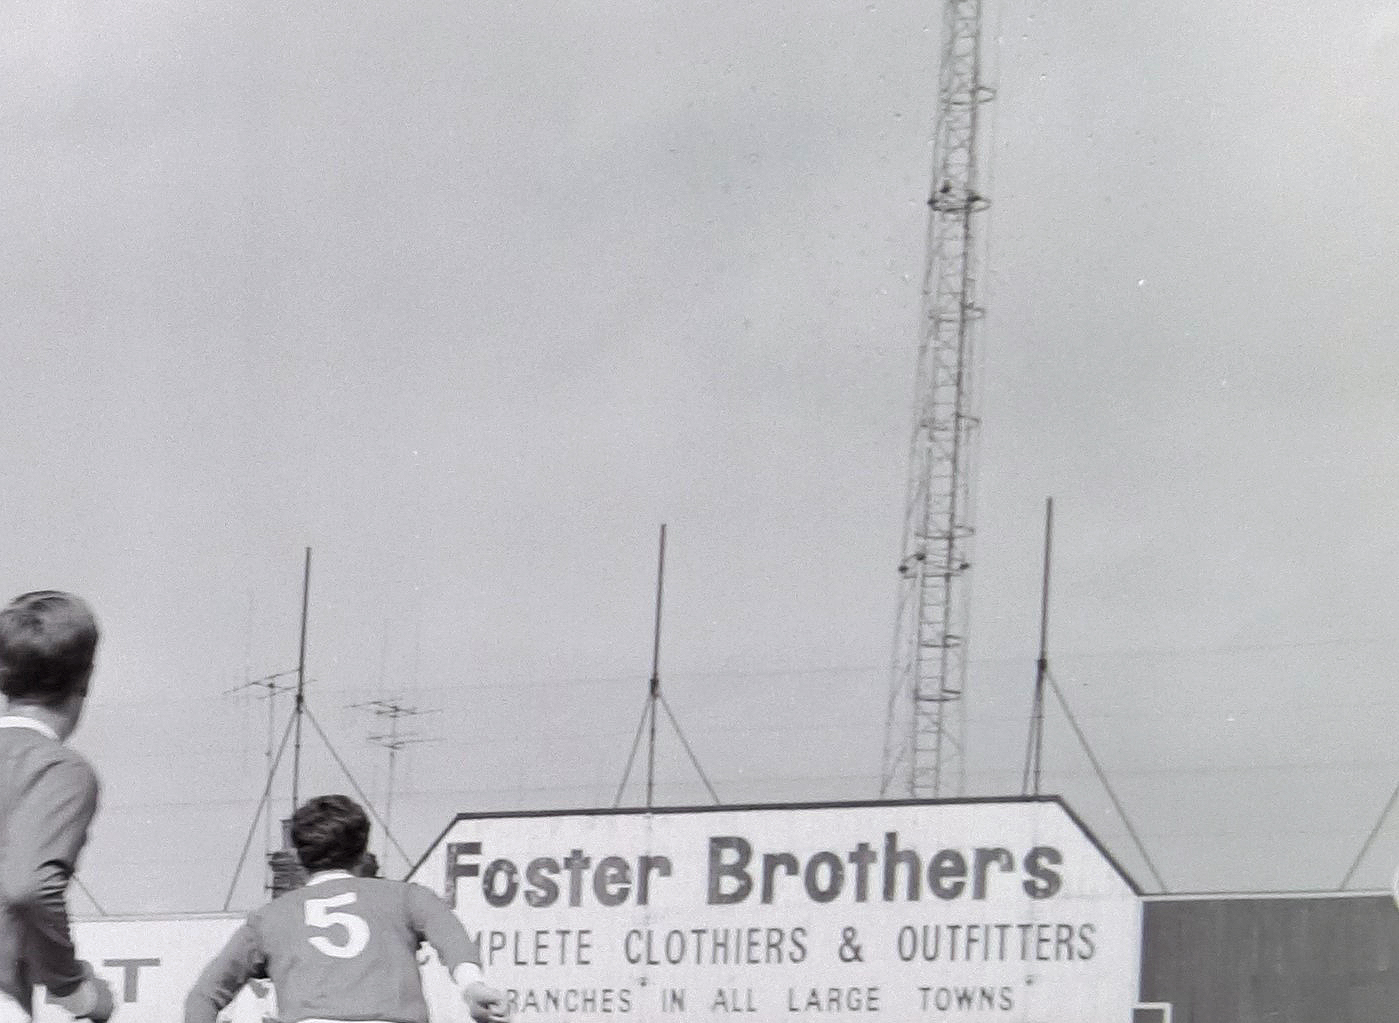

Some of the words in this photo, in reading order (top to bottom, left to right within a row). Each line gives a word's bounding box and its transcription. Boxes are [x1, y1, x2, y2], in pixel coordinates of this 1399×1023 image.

[446, 842, 672, 908] Foster
[708, 832, 1062, 905] Brothers
[304, 892, 371, 958] 5
[624, 927, 807, 965] CLOTHIERS
[839, 927, 864, 964] &
[898, 923, 1096, 963] OUTFITTERS
[504, 989, 631, 1014] RANCHES
[661, 989, 686, 1012] IN
[712, 988, 758, 1013] ALL
[788, 987, 881, 1013] LARGE
[919, 986, 1014, 1012] TOWNS
